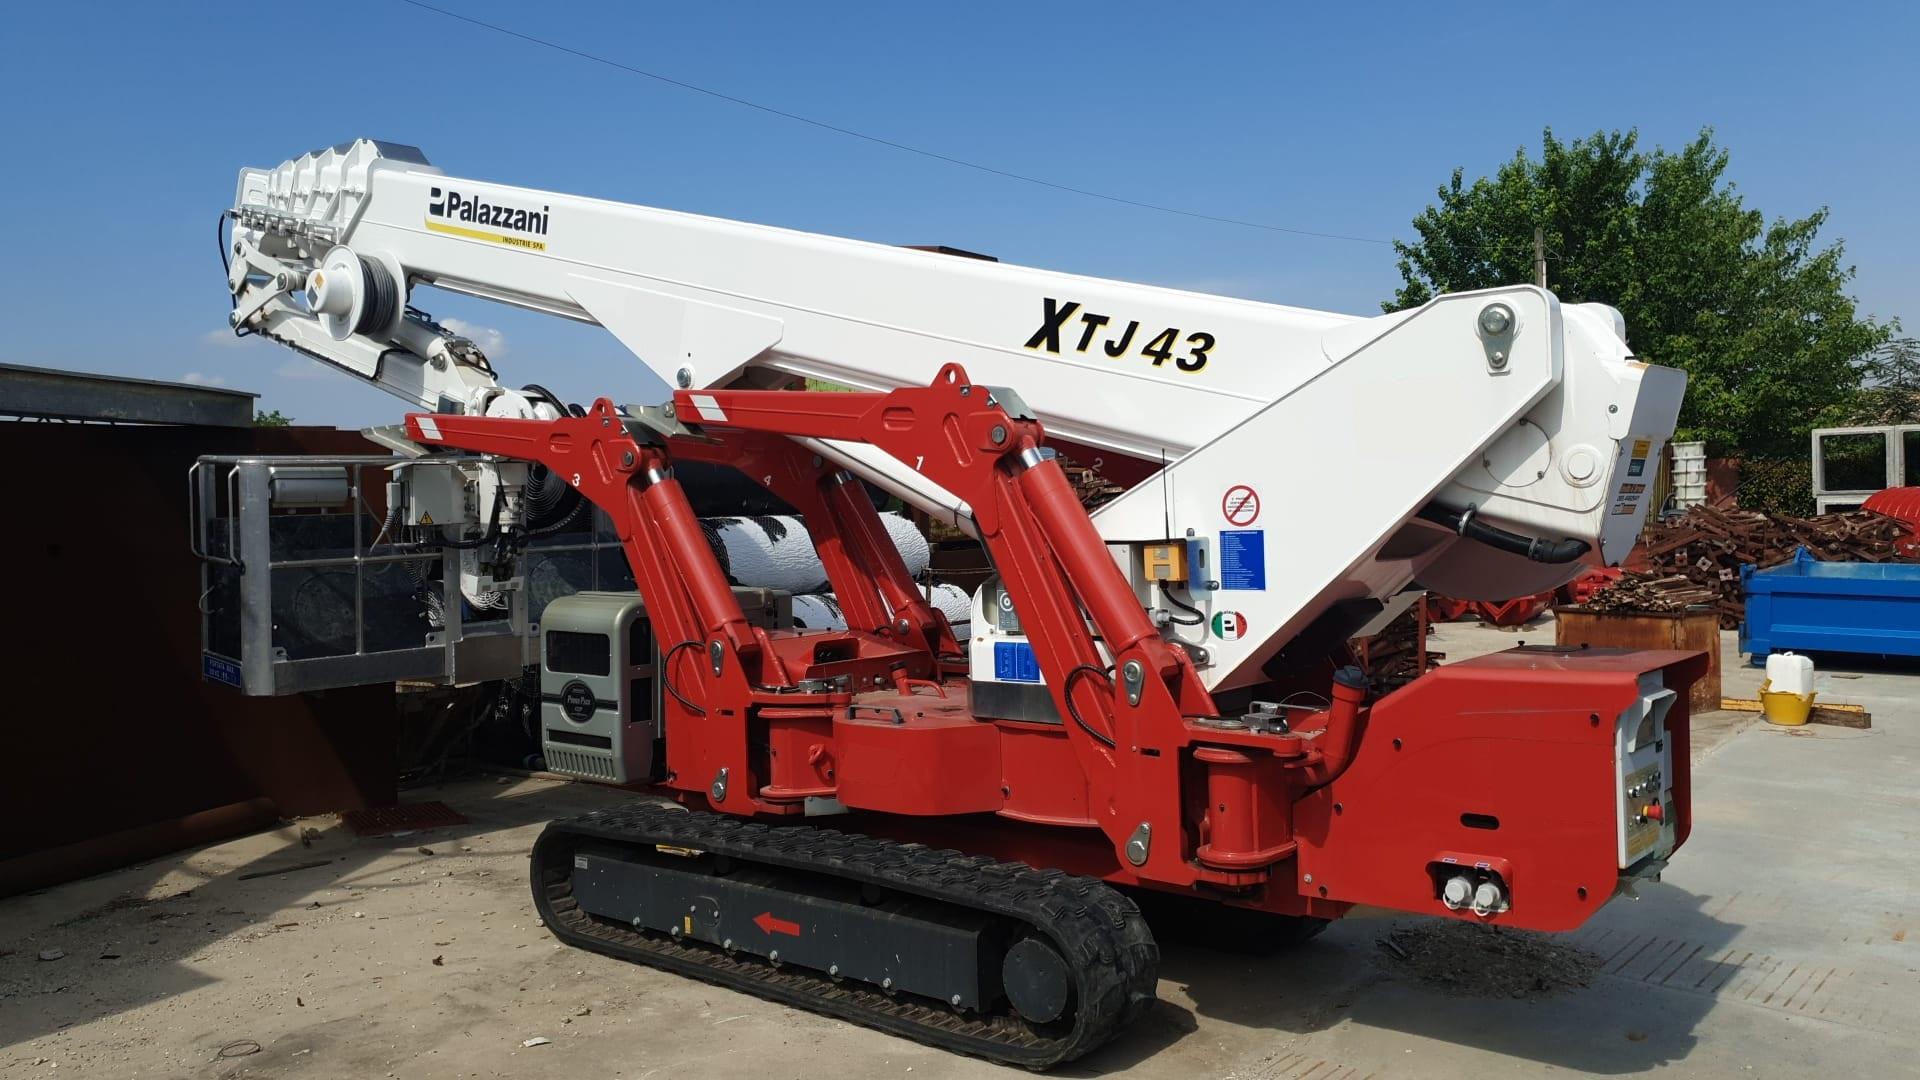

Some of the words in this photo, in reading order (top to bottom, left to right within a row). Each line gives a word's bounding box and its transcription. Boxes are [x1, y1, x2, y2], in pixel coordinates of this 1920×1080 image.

[447, 191, 549, 235] Palazzani
[502, 236, 531, 248] INDUSTRIE
[532, 242, 544, 250] SPA
[916, 455, 924, 471] 1
[1092, 457, 1103, 472] 2
[572, 473, 581, 487] 3
